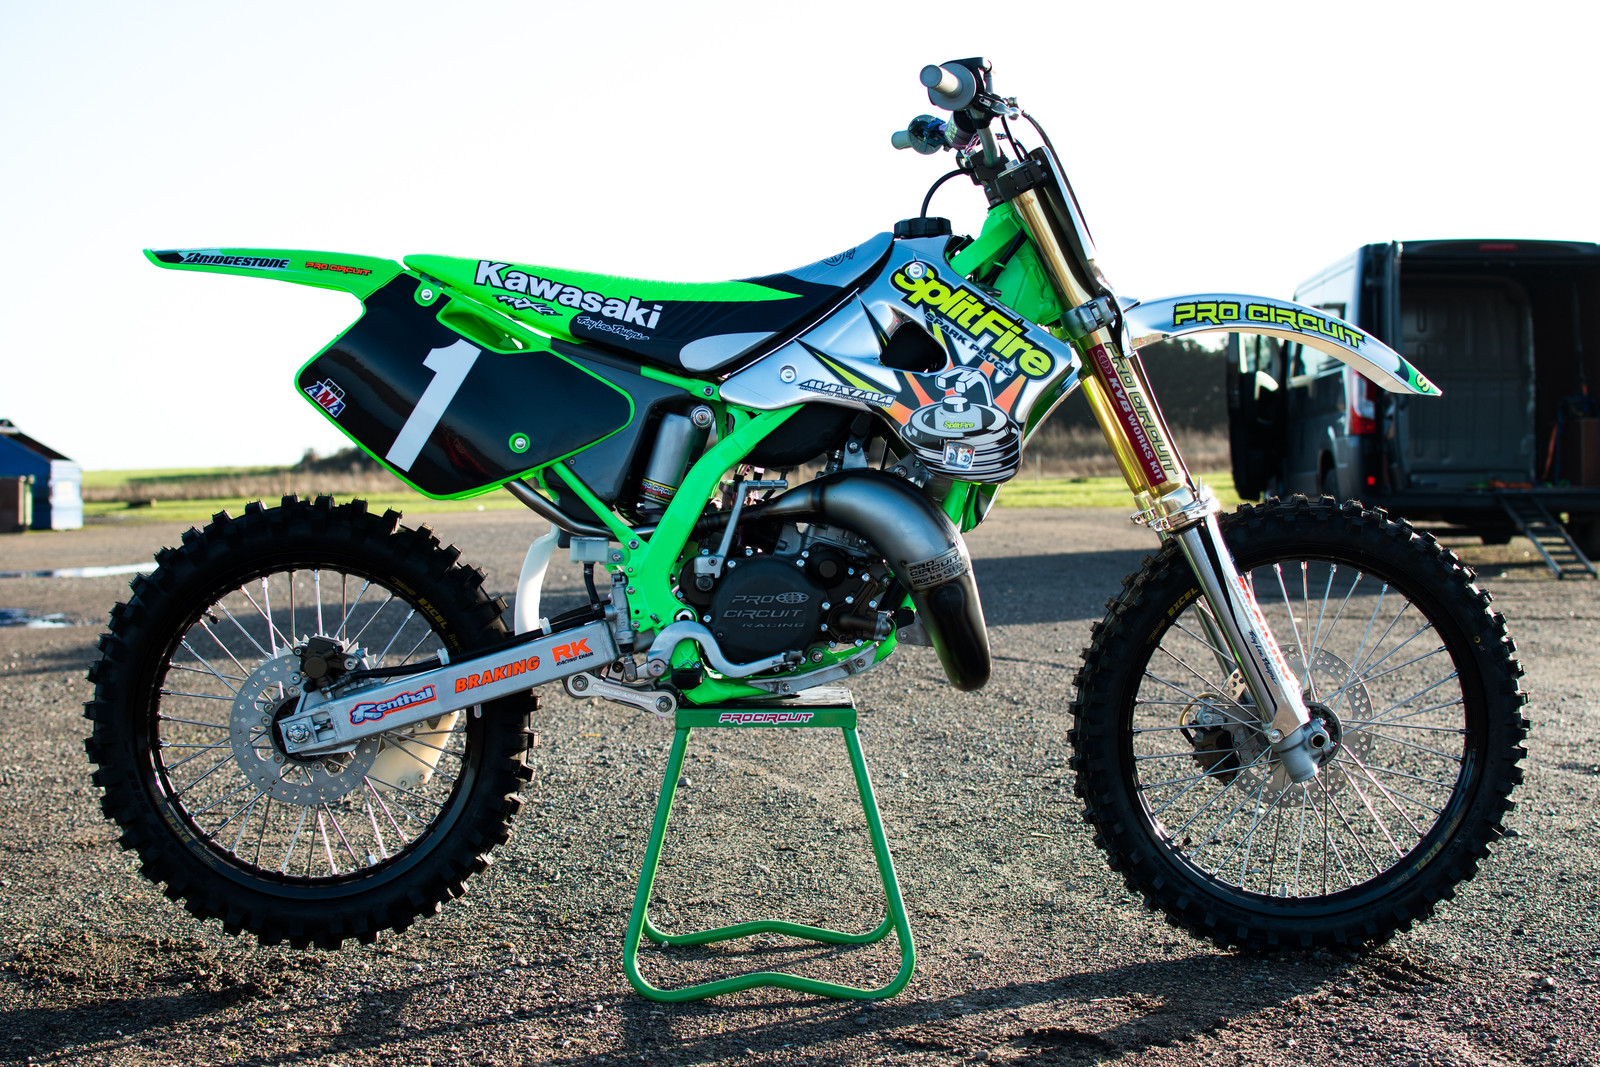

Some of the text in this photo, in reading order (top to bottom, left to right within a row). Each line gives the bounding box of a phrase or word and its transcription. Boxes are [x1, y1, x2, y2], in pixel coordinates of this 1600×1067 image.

[185, 252, 290, 269] BRIDGESTONE
[306, 262, 372, 275] PRO CIRCUIT
[474, 260, 663, 329] Kawasaki
[893, 262, 1052, 377] SplitFire
[1173, 301, 1366, 348] PRO CIRCUIT
[925, 312, 1014, 377] SPARK PLUGS
[305, 381, 345, 417] AMA
[326, 380, 344, 398] PRO
[385, 339, 482, 472] 1
[1104, 342, 1178, 474] PRO CIRCUIT
[943, 421, 974, 430] SplitFire
[1109, 378, 1164, 480] KYB WORKS KIT
[909, 561, 934, 572] PRO
[910, 555, 959, 577] CIRCUIT
[912, 573, 942, 585] Works
[418, 597, 447, 629] EXCEL
[723, 609, 803, 619] CIRCUIT
[732, 595, 775, 605] PRO
[1167, 588, 1198, 617] EXCEL
[551, 637, 592, 662] RK
[556, 651, 594, 666] RACING CHAIN
[455, 656, 540, 693] BRAKING
[350, 685, 436, 724] Renthal
[1413, 841, 1443, 871] EXCEL
